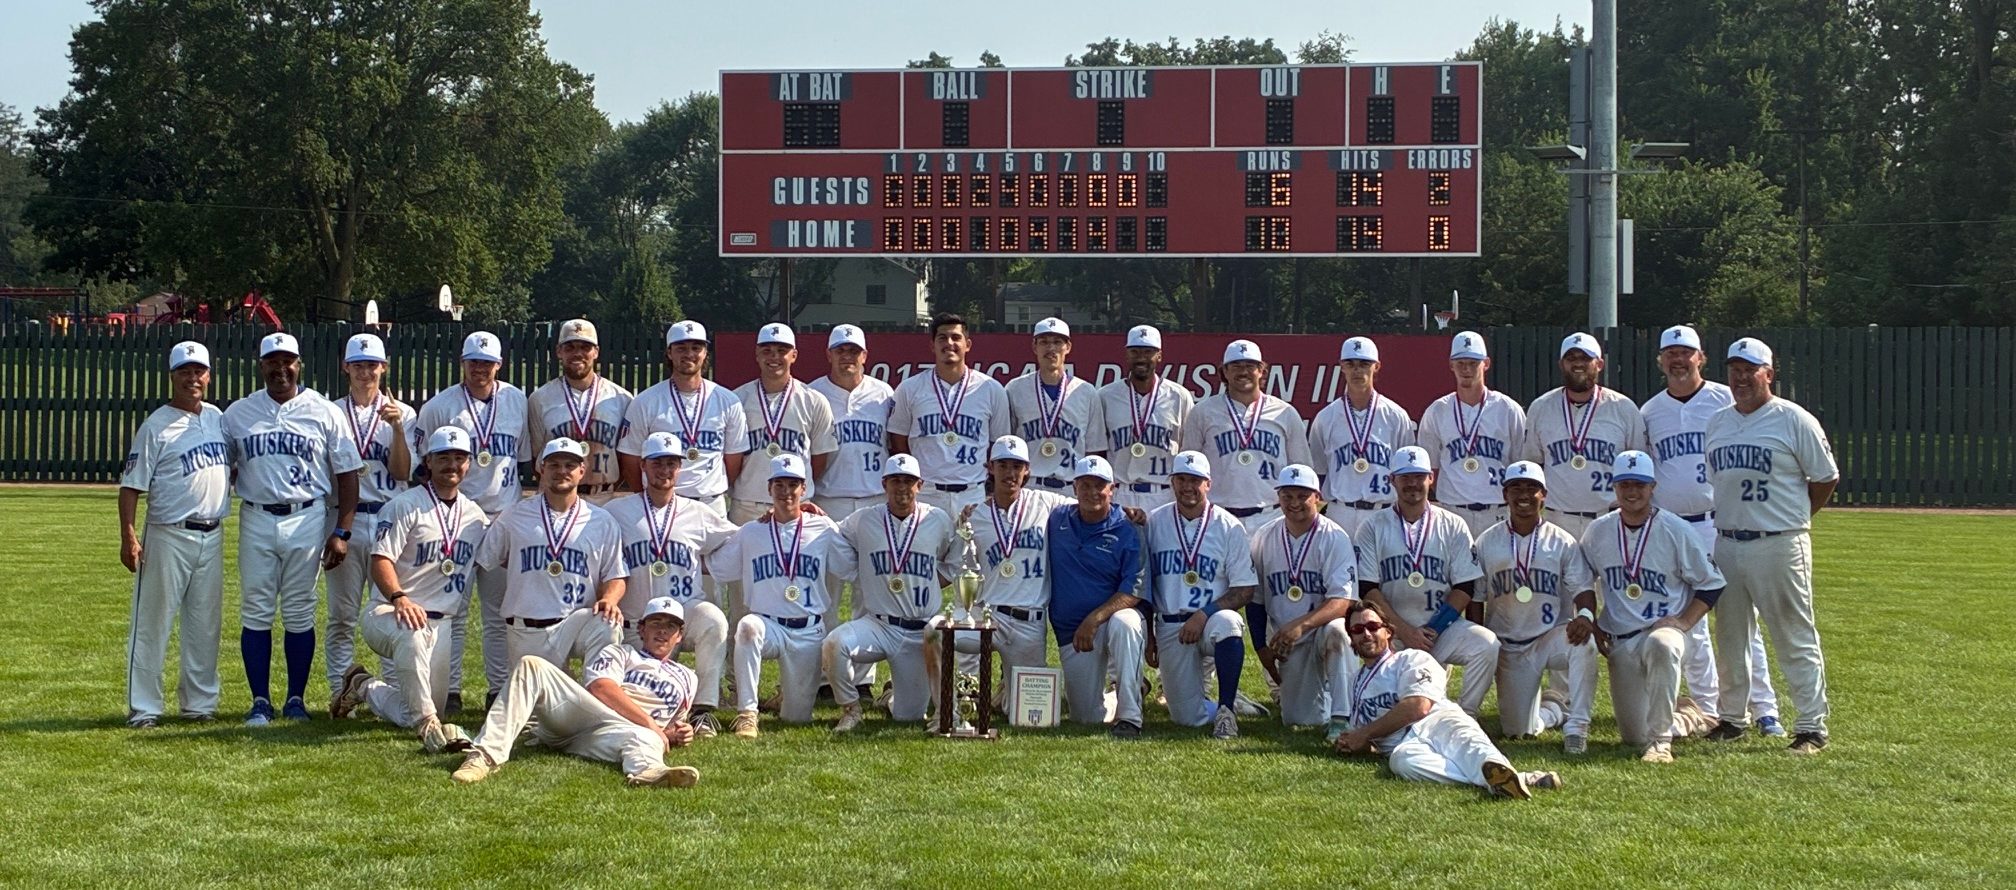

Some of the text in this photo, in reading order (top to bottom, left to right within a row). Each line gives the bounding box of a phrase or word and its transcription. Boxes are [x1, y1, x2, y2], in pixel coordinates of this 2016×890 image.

[779, 73, 843, 100] AT BAT
[933, 72, 978, 99] BALL
[1075, 70, 1146, 98] STRIKE
[1260, 68, 1300, 97] OUT
[1375, 67, 1387, 95] H
[1441, 66, 1451, 94] E
[890, 152, 1165, 172] 1 2 3 4 5 6 7 8 9 10
[1247, 151, 1290, 170] RUNS
[1341, 151, 1379, 169] HITS
[1408, 150, 1472, 169] ERRORS
[774, 177, 869, 205] GUESTS
[884, 173, 1449, 207] 0 0 0 2 4 0 0 0 0 6 14 2
[788, 220, 855, 248] HOME
[884, 218, 903, 250] 0
[913, 218, 932, 250] 0
[943, 218, 961, 250] 0
[1001, 218, 1019, 250] 0
[1030, 218, 1048, 250] 4
[1088, 218, 1107, 250] 4
[1261, 217, 1291, 249] 10
[1352, 217, 1382, 249] 14
[1429, 217, 1449, 249] 0
[551, 419, 612, 449] MUKIES
[833, 420, 883, 447] USKIES
[917, 413, 981, 442] MUSKIES
[243, 431, 315, 463] MUSKIES
[955, 443, 978, 466] 48
[1214, 430, 1280, 458] MUKIES
[1655, 431, 1705, 465] MUSKI
[179, 441, 229, 477] MUSKI
[592, 453, 609, 474] 17
[863, 451, 886, 473] 15
[1149, 456, 1173, 476] 11
[1709, 443, 1772, 475] MUSKIES
[373, 471, 397, 491] 16
[1369, 474, 1392, 495] 43
[1590, 470, 1614, 493] 22
[1740, 479, 1769, 502] 25
[520, 545, 589, 578] MUSKIES
[752, 552, 820, 583] MUSIES
[874, 549, 935, 582] MUKIES
[1021, 556, 1045, 580] 14
[563, 582, 586, 604] 32
[670, 574, 694, 598] 38
[1605, 566, 1669, 598] USKIES
[803, 586, 814, 608] 1
[912, 585, 931, 608] 10
[1186, 586, 1214, 608] 27
[1541, 602, 1554, 625] 8
[1641, 601, 1669, 620] 45
